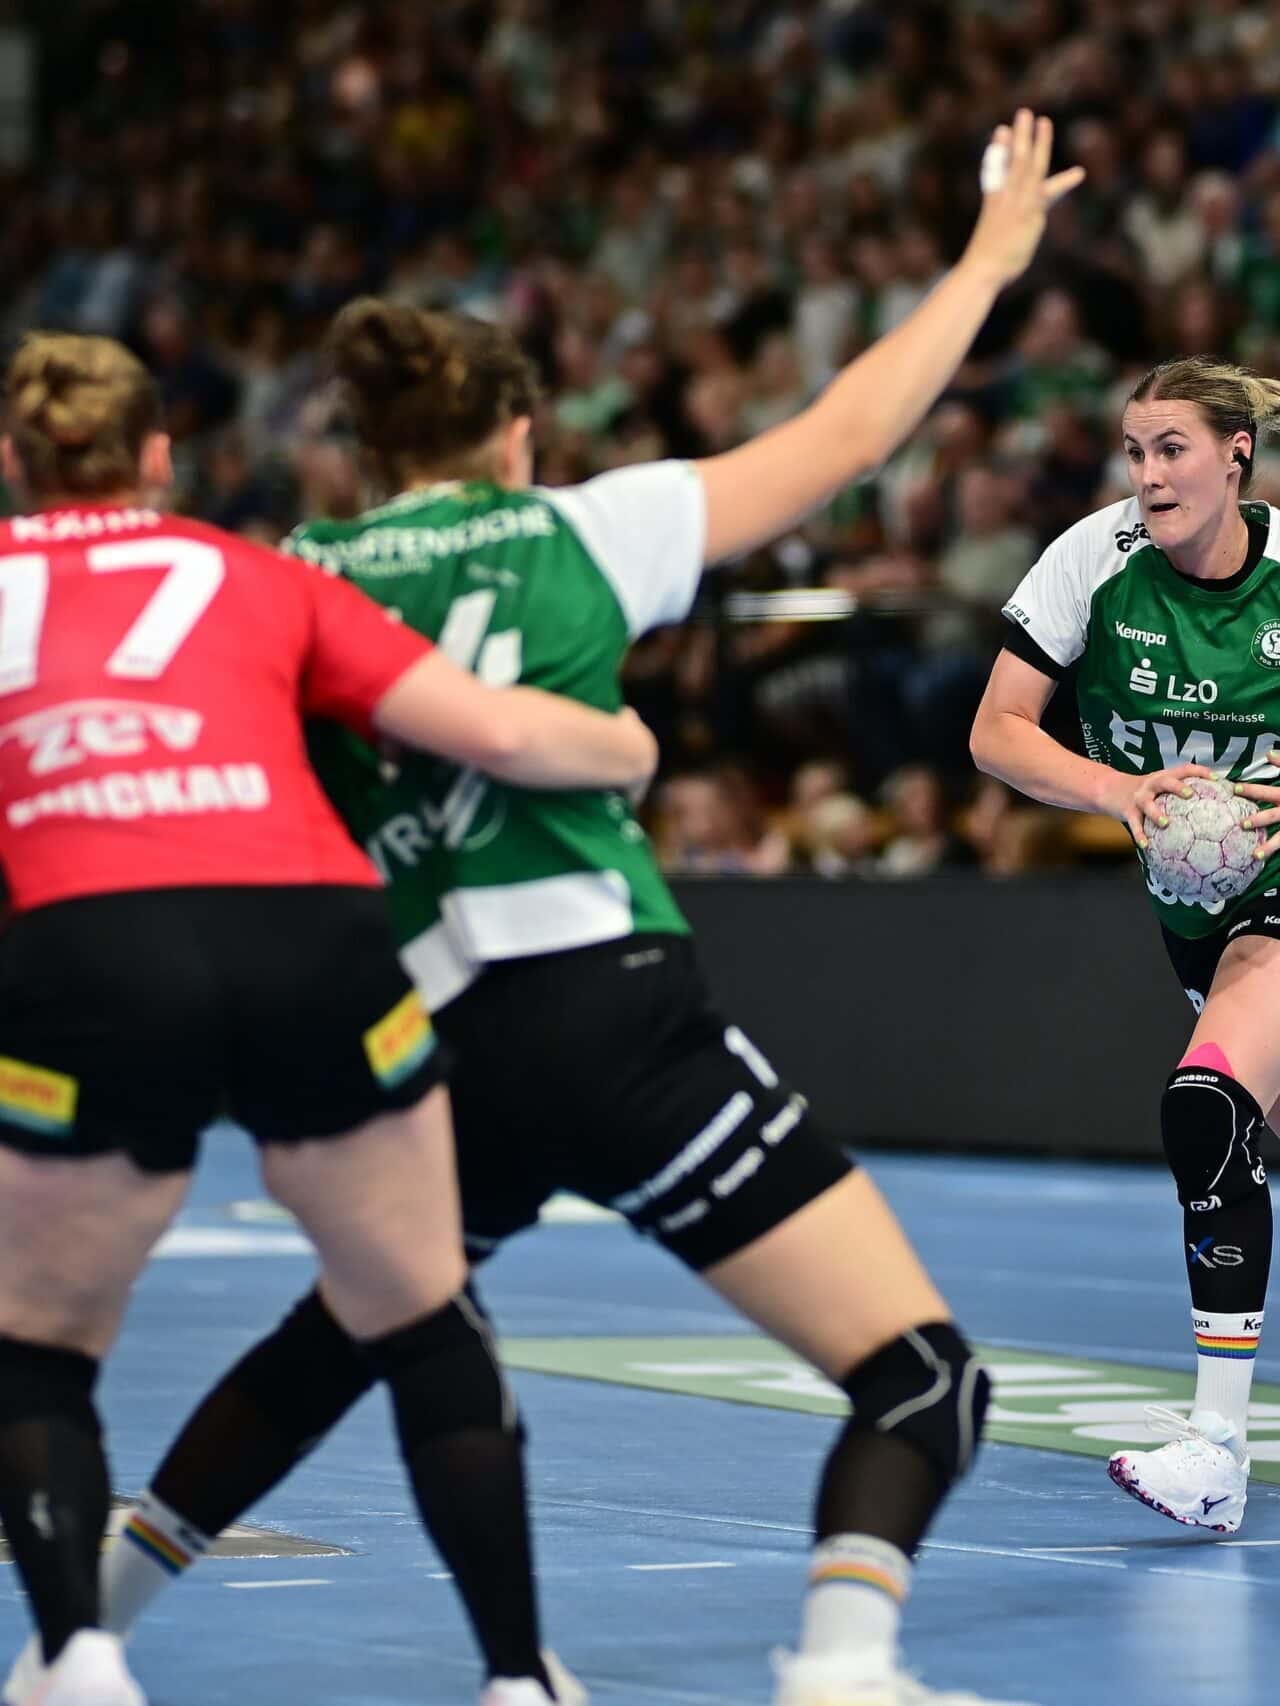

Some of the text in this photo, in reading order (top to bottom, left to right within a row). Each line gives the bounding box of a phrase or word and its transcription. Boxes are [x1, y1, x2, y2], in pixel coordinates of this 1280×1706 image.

[0, 535, 226, 692] 17
[1115, 620, 1167, 647] Kempa
[1166, 674, 1218, 704] LzO
[1162, 707, 1266, 724] meine Sparkasse
